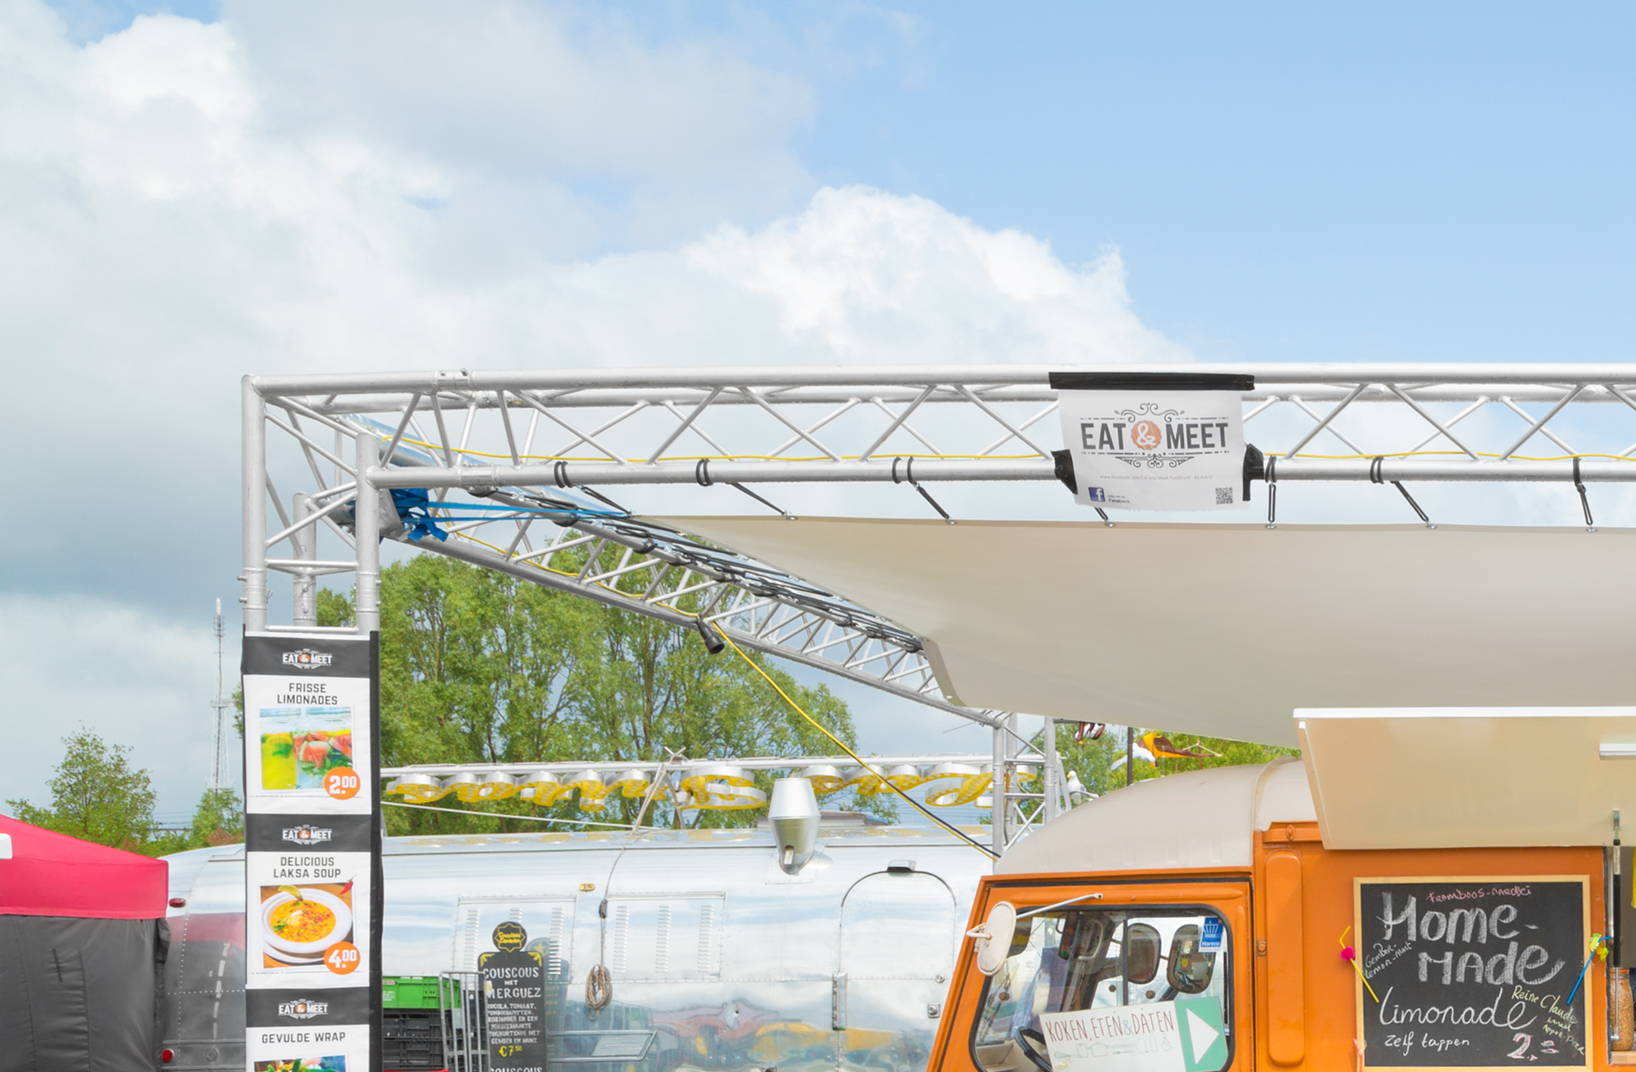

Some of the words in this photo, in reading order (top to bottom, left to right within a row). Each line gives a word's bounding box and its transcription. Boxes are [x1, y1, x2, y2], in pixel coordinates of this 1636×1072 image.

[1081, 423, 1126, 450] EAT
[1137, 422, 1156, 446] &
[1166, 423, 1228, 449] MEET
[282, 653, 299, 663] EAT
[310, 653, 332, 664] MEET
[289, 683, 326, 693] FRISSE
[277, 695, 338, 705] LIMONADES
[329, 776, 357, 794] 2.00
[282, 830, 299, 840] EAT
[310, 830, 332, 840] MEET
[280, 857, 335, 867] DELICIOUS
[273, 869, 310, 878] LAKSA
[313, 869, 341, 878] SOUP
[328, 949, 357, 968] 4.00
[483, 967, 539, 979] COUSCOUS
[278, 1004, 294, 1014] EAT
[307, 1004, 328, 1014] MEET
[261, 1033, 310, 1044] GEVULDE
[315, 1032, 346, 1042] WRAP
[1421, 1033, 1470, 1052] tappen
